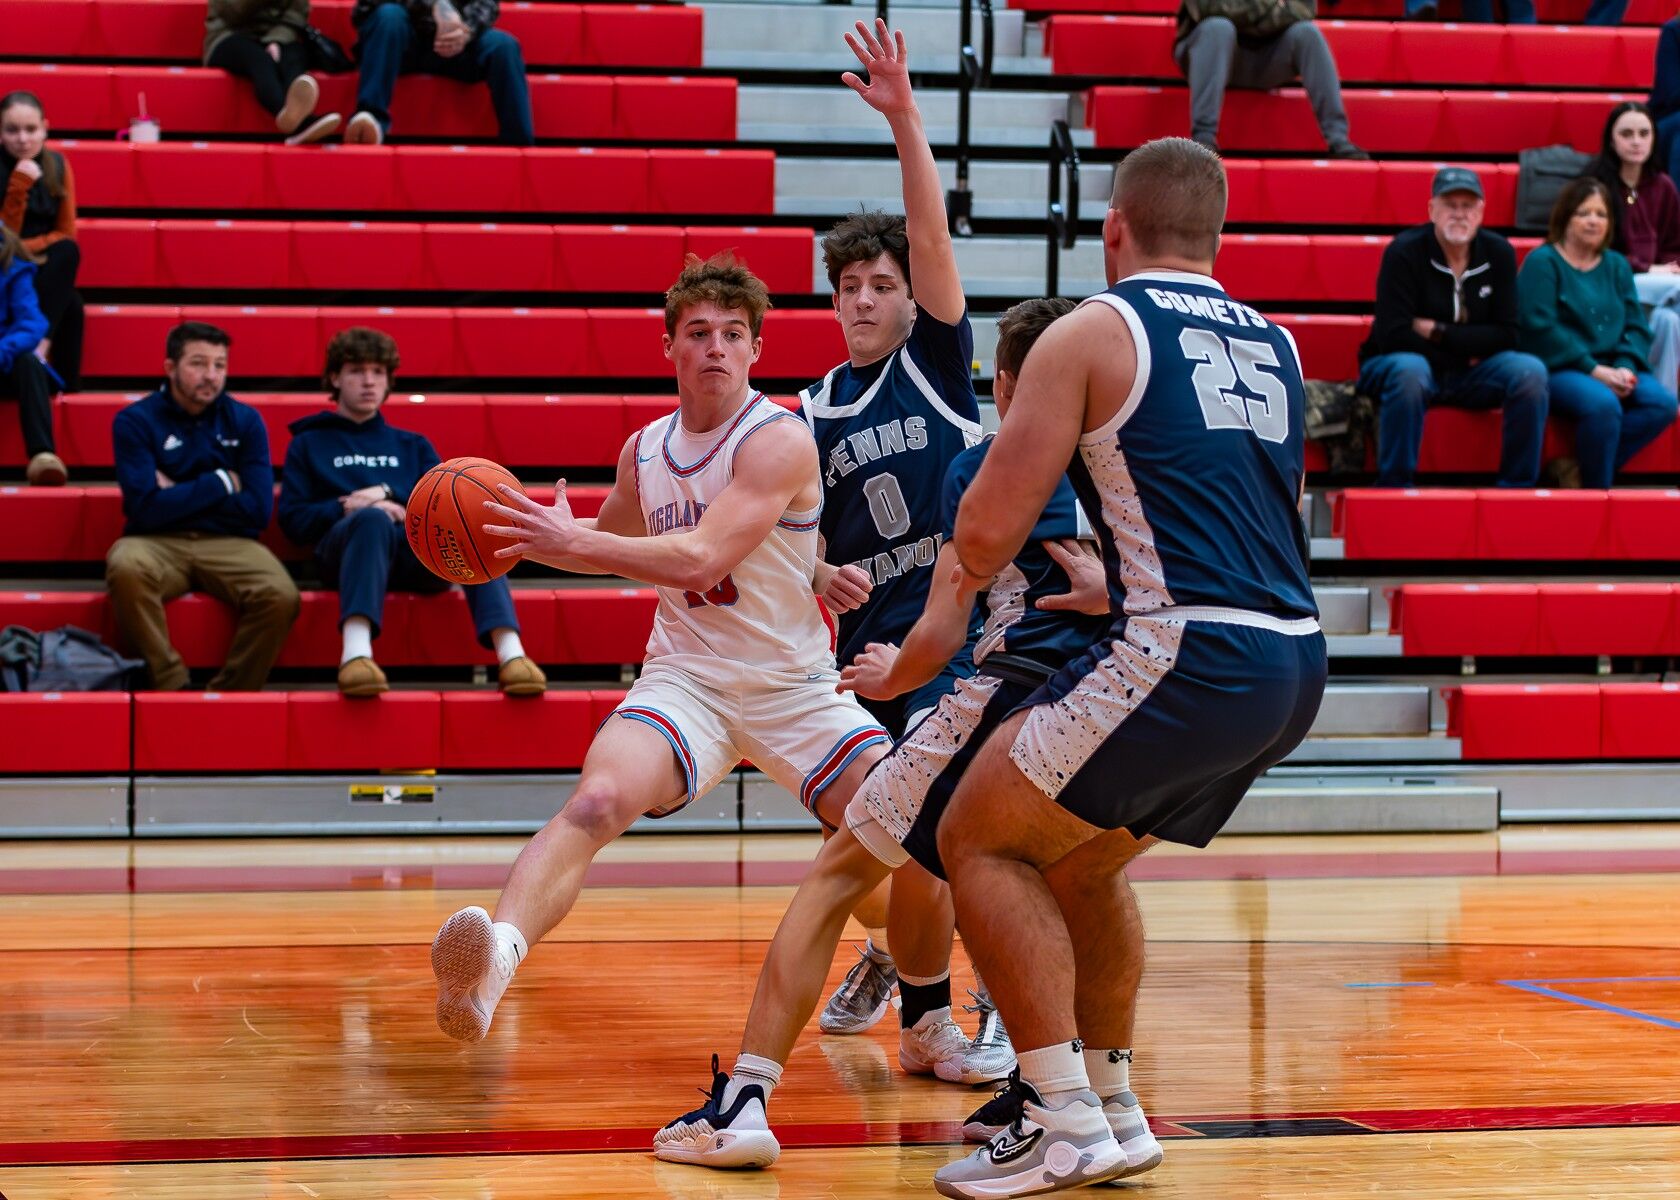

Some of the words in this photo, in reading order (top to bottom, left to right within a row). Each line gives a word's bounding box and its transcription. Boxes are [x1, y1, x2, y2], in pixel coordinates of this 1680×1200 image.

[1145, 288, 1269, 329] COMETS
[1178, 327, 1289, 444] 25
[333, 454, 399, 468] COMETS
[862, 471, 912, 540] 0
[433, 524, 467, 581] EGACY
